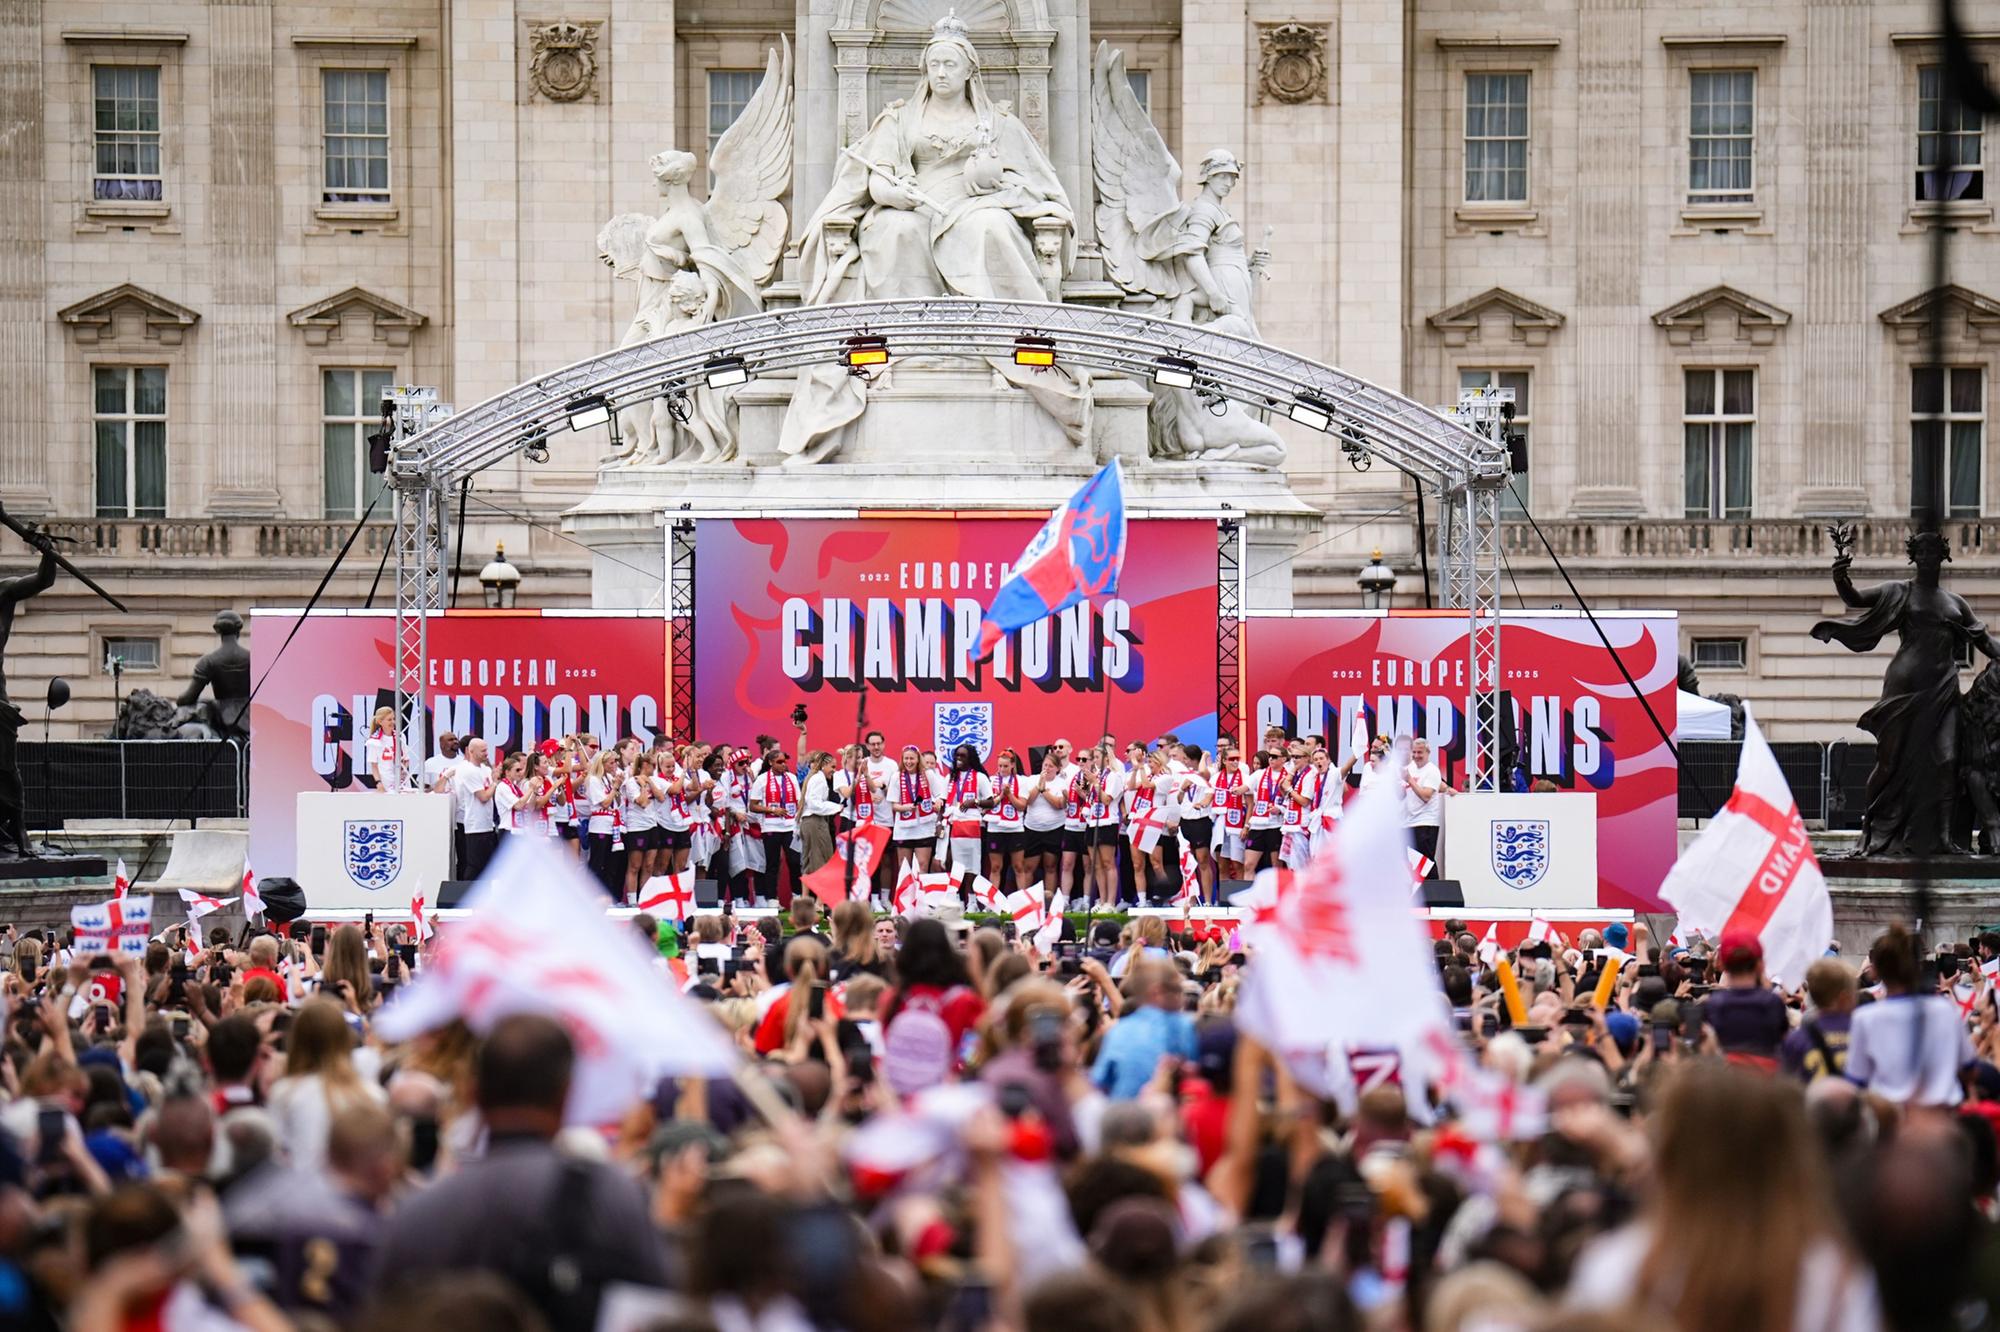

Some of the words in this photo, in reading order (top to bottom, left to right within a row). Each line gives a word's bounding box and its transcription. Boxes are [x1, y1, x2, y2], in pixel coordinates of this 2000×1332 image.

[859, 573, 890, 582] 2022
[900, 562, 1011, 589] EUROPEA
[429, 659, 556, 687] EUROPEAN
[565, 669, 598, 678] 2025
[1332, 670, 1362, 679] 2022
[1507, 670, 1539, 678] 2025
[1256, 694, 1600, 776] CHAMPNS
